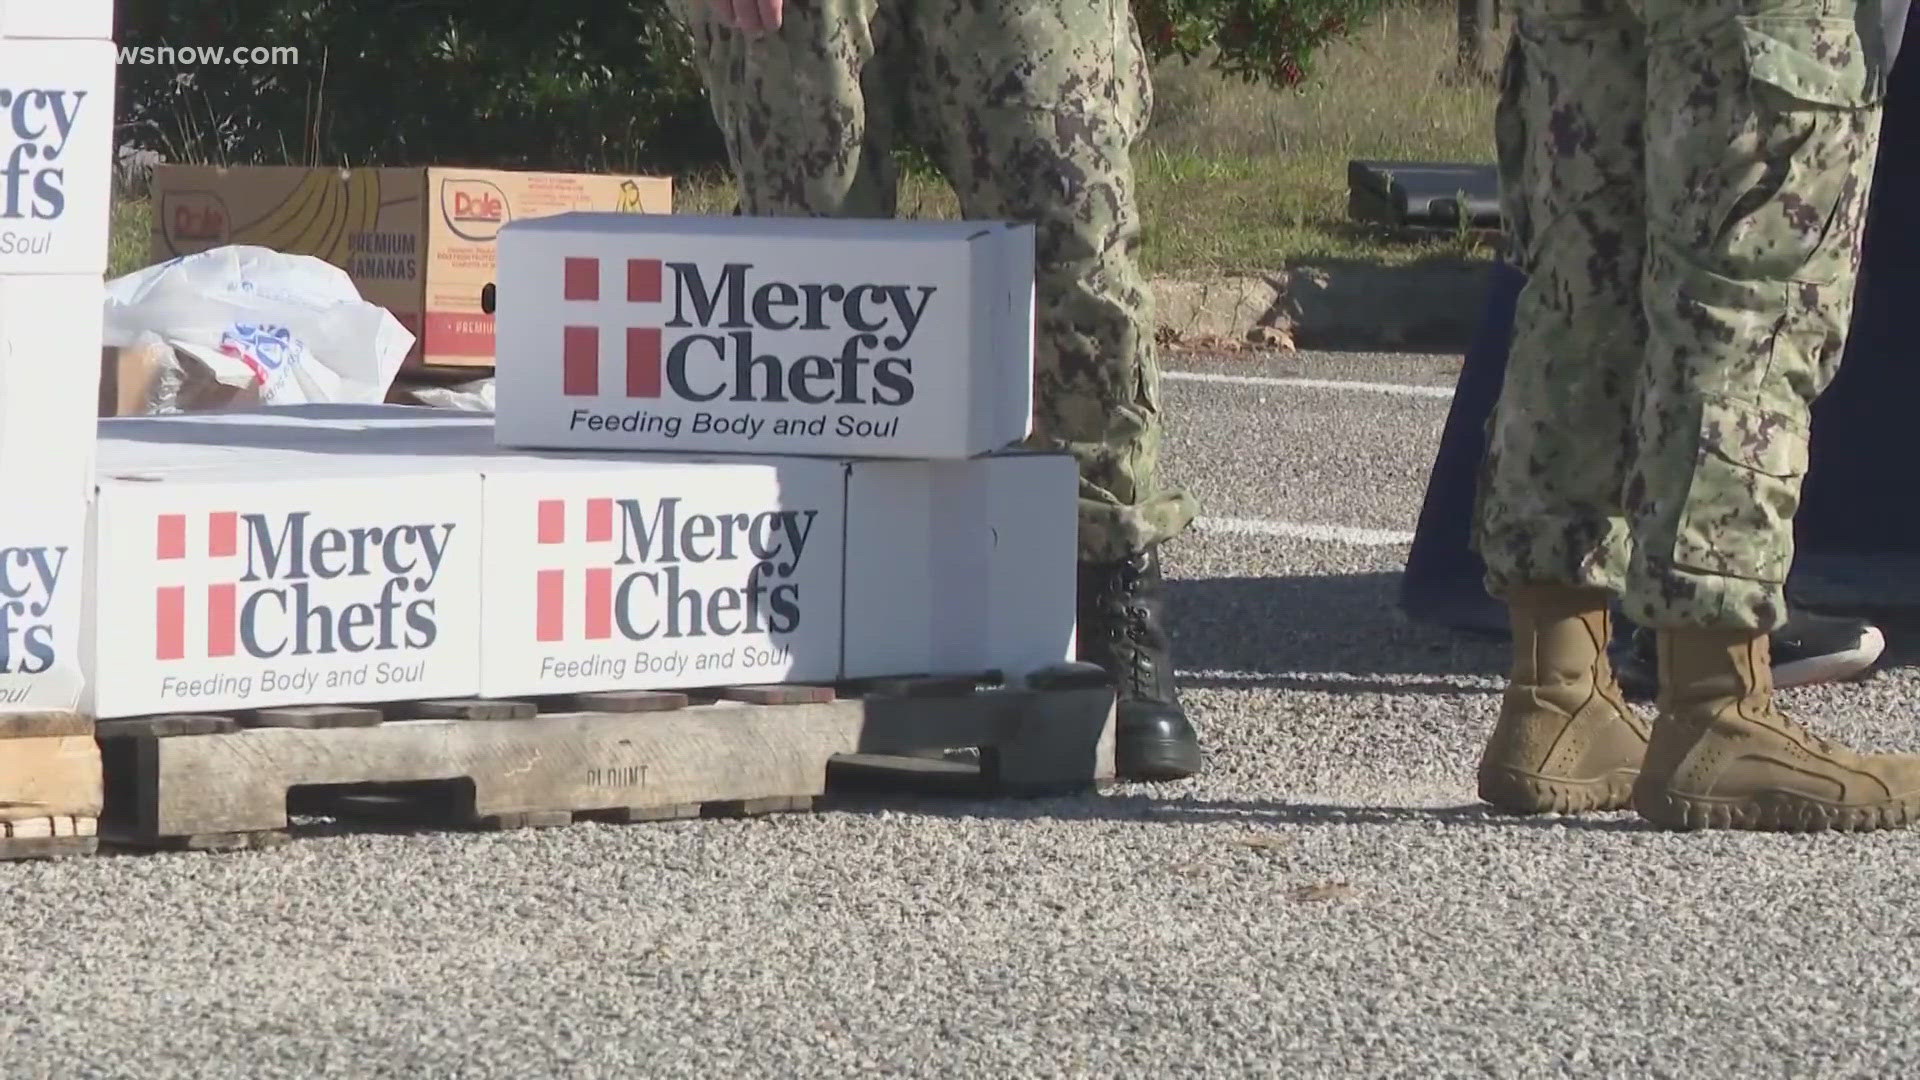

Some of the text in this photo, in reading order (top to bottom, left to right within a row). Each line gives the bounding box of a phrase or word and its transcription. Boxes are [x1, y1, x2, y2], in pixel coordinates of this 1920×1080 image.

[0, 89, 87, 160] cy
[455, 190, 501, 216] Dole
[0, 231, 52, 254] Soul
[348, 233, 416, 255] PREMIUM
[456, 321, 497, 335] PREMIU
[665, 262, 937, 351] Mercy
[666, 331, 915, 406] Chefs
[570, 409, 899, 440] Feeding Body and Soul
[240, 511, 456, 592] Mercy
[615, 497, 818, 578] Mercy
[240, 576, 437, 659] Chefs
[615, 560, 800, 641] Chefs
[161, 660, 425, 699] Feeding Body and Soul
[540, 643, 790, 680] Feeding Body and Soul
